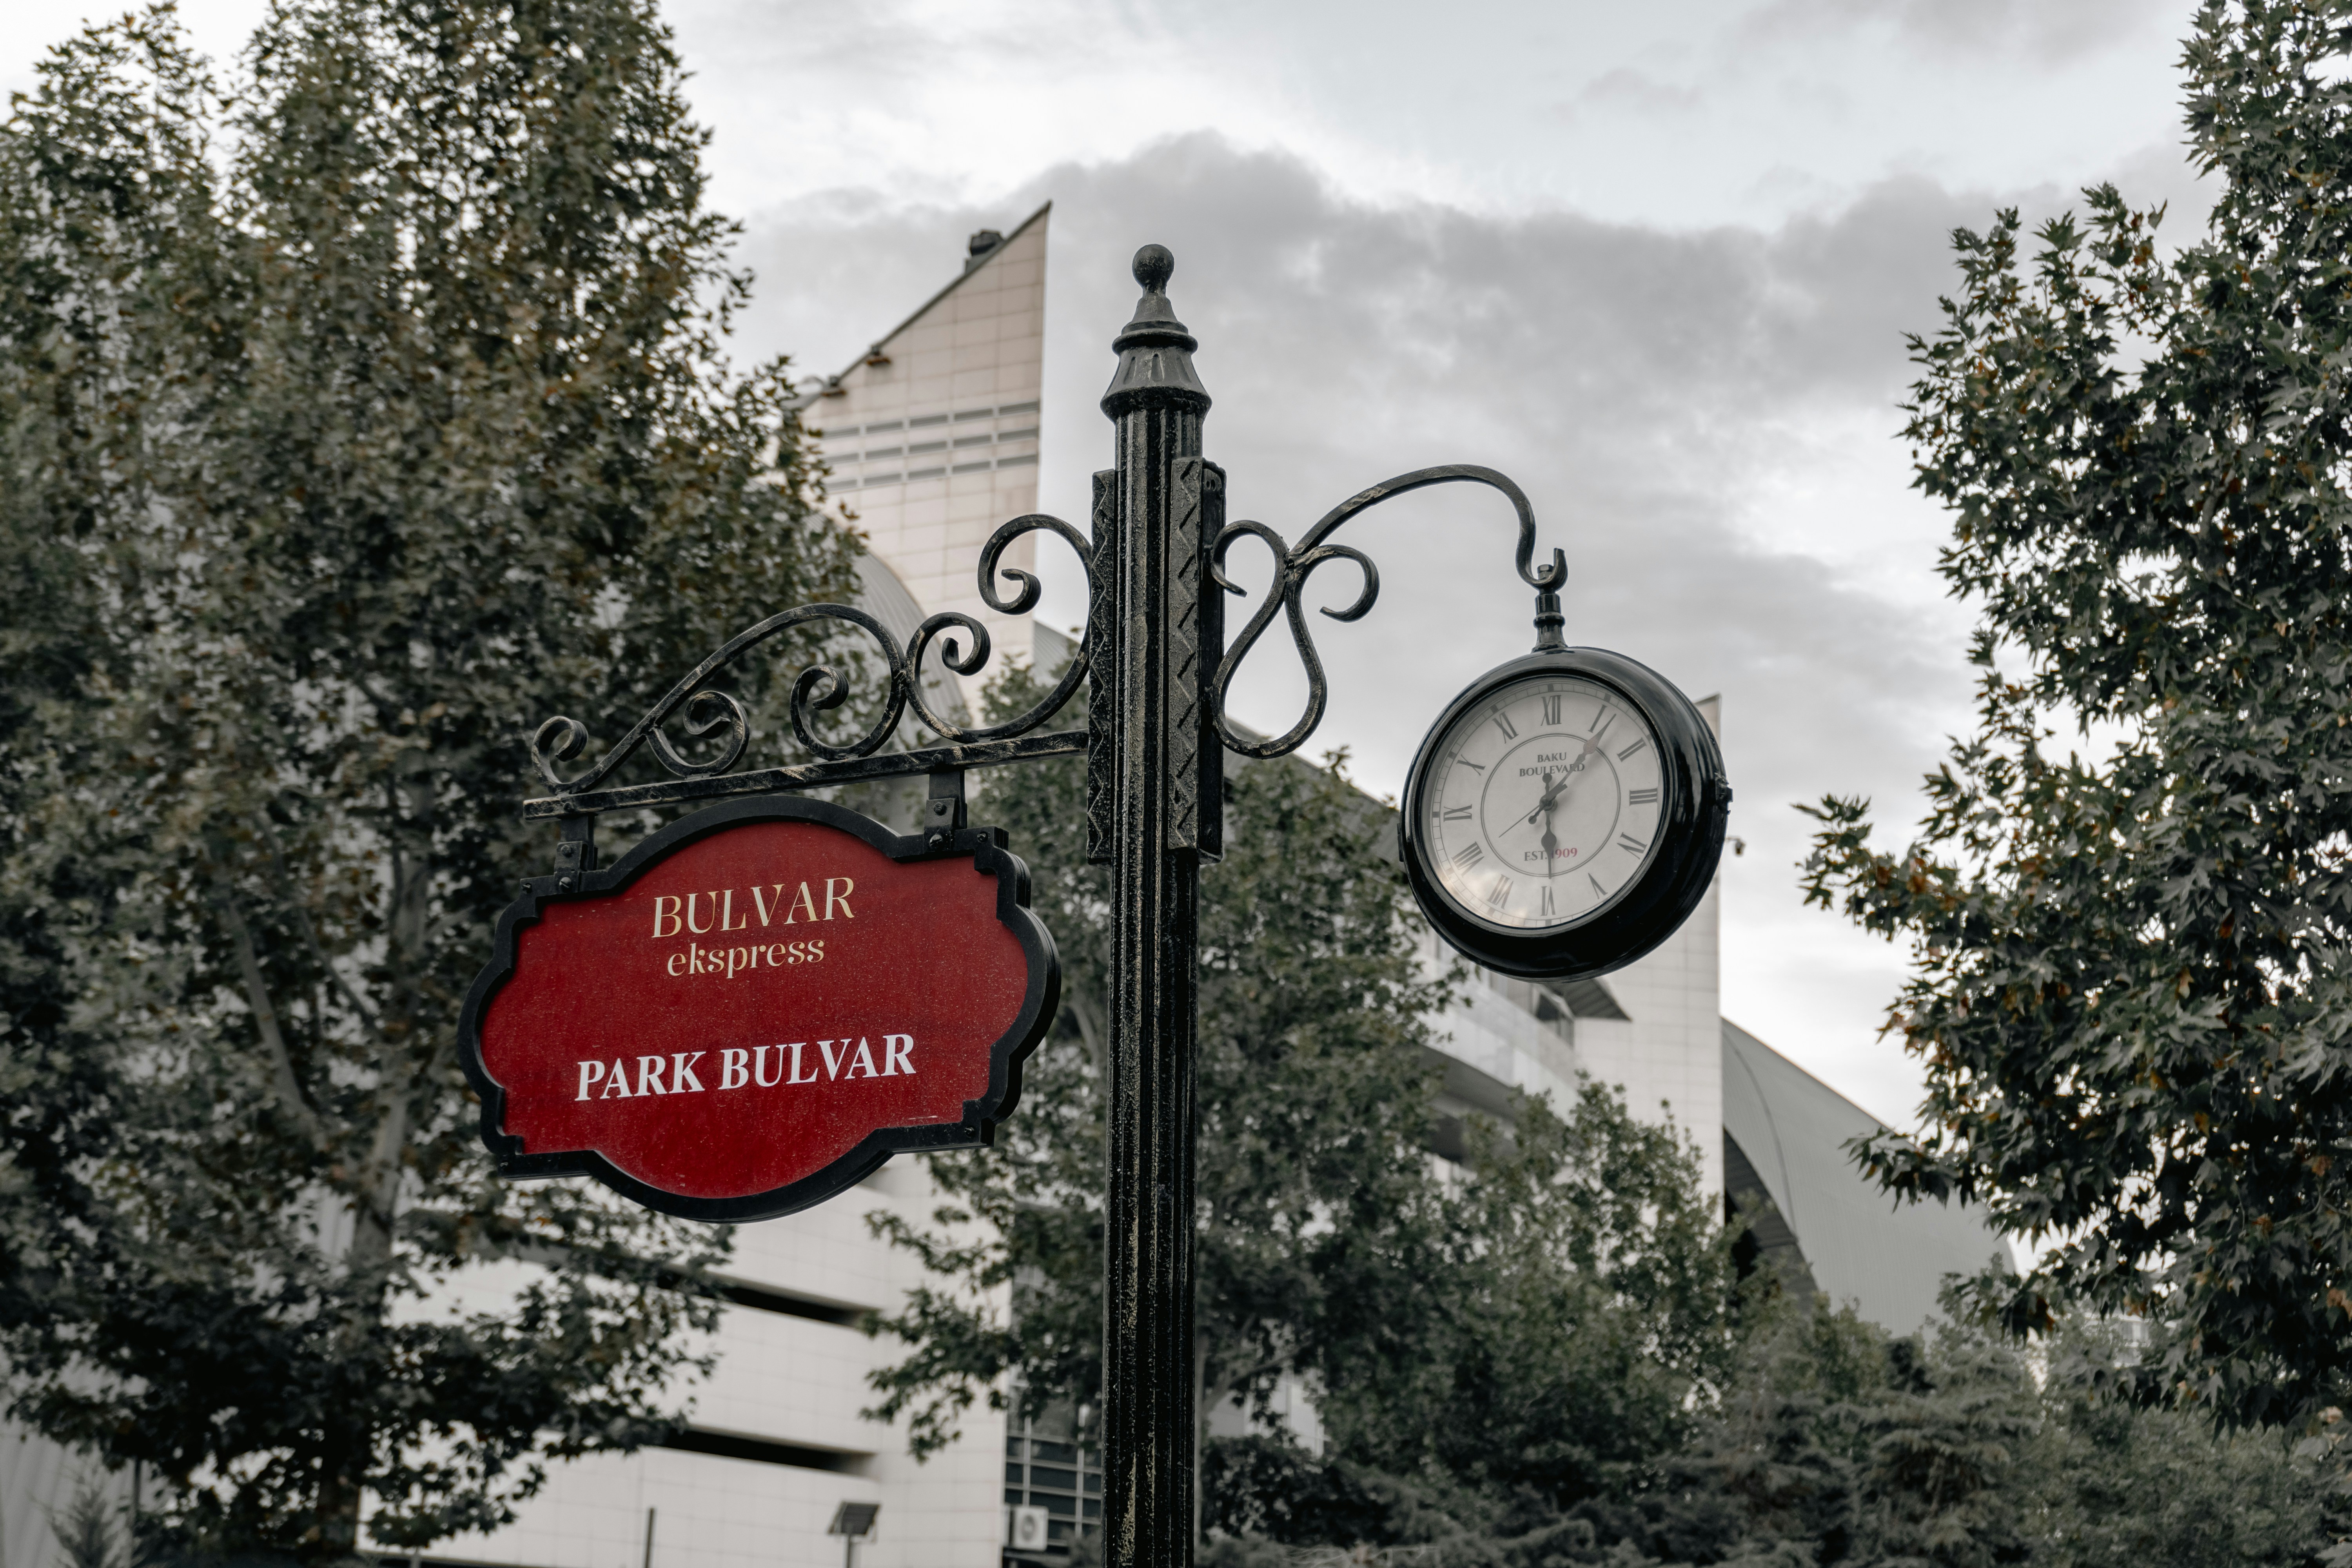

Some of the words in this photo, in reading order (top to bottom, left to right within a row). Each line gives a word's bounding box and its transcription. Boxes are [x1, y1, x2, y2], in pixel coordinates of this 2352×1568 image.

[1541, 695, 1562, 726] XII
[1588, 704, 1607, 733] I
[1492, 711, 1519, 744] XI
[1537, 752, 1566, 762] BAKU
[1617, 737, 1646, 762] II
[1456, 754, 1486, 776] X
[1629, 787, 1658, 806] III
[1443, 804, 1472, 822] IX
[1451, 841, 1485, 878] VIII
[1524, 850, 1547, 861] EST.
[1617, 832, 1648, 860] IV
[1487, 874, 1514, 909] VII
[1588, 873, 1608, 899] V
[652, 877, 855, 938] BULVAR
[1541, 886, 1556, 916] VI
[667, 940, 824, 978] ekspress
[575, 1051, 706, 1101] PARK
[718, 1033, 916, 1090] BULVAR
